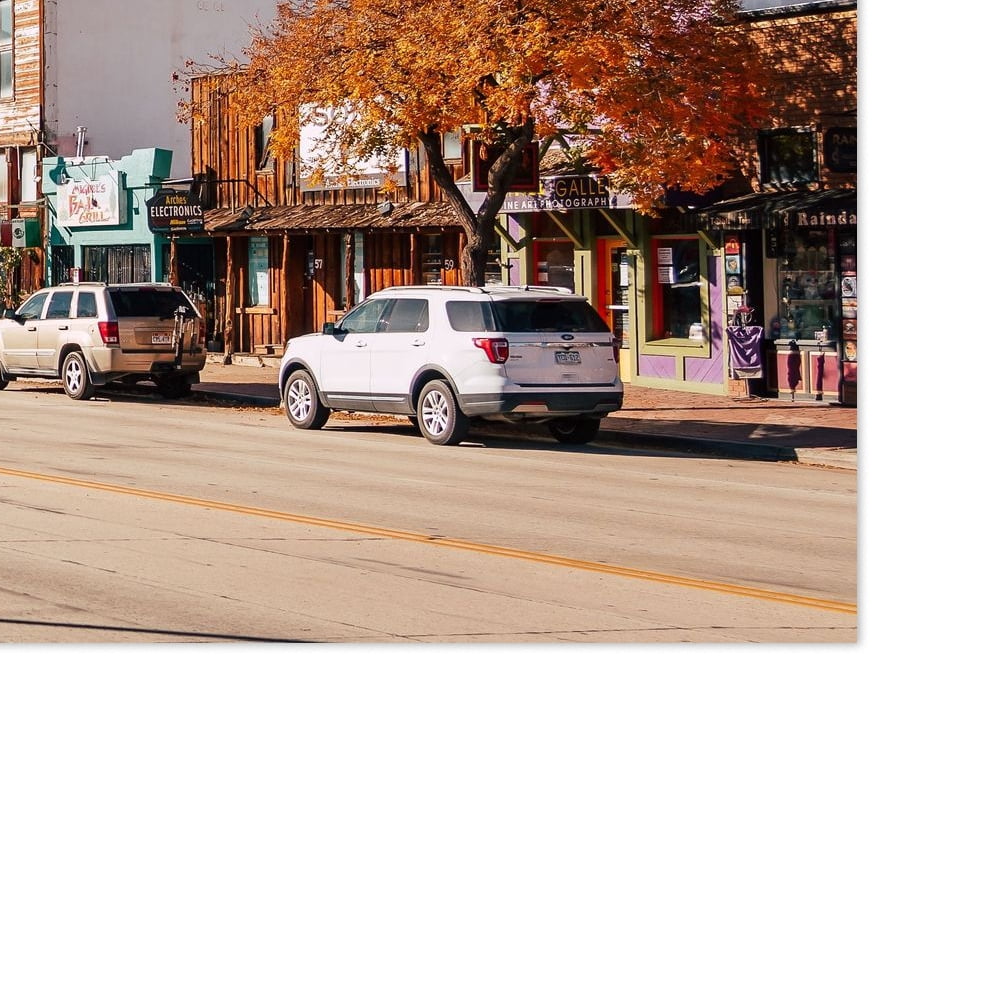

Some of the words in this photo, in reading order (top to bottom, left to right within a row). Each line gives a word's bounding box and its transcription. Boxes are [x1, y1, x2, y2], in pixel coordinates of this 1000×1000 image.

[165, 195, 187, 205] Arches
[501, 201, 519, 210] INE
[521, 200, 537, 209] ART
[540, 197, 612, 209] PHOTOGRAPHY
[150, 205, 202, 217] ELECTRONICS
[79, 211, 110, 224] GRILL
[314, 259, 323, 269] 57
[444, 260, 454, 270] 59
